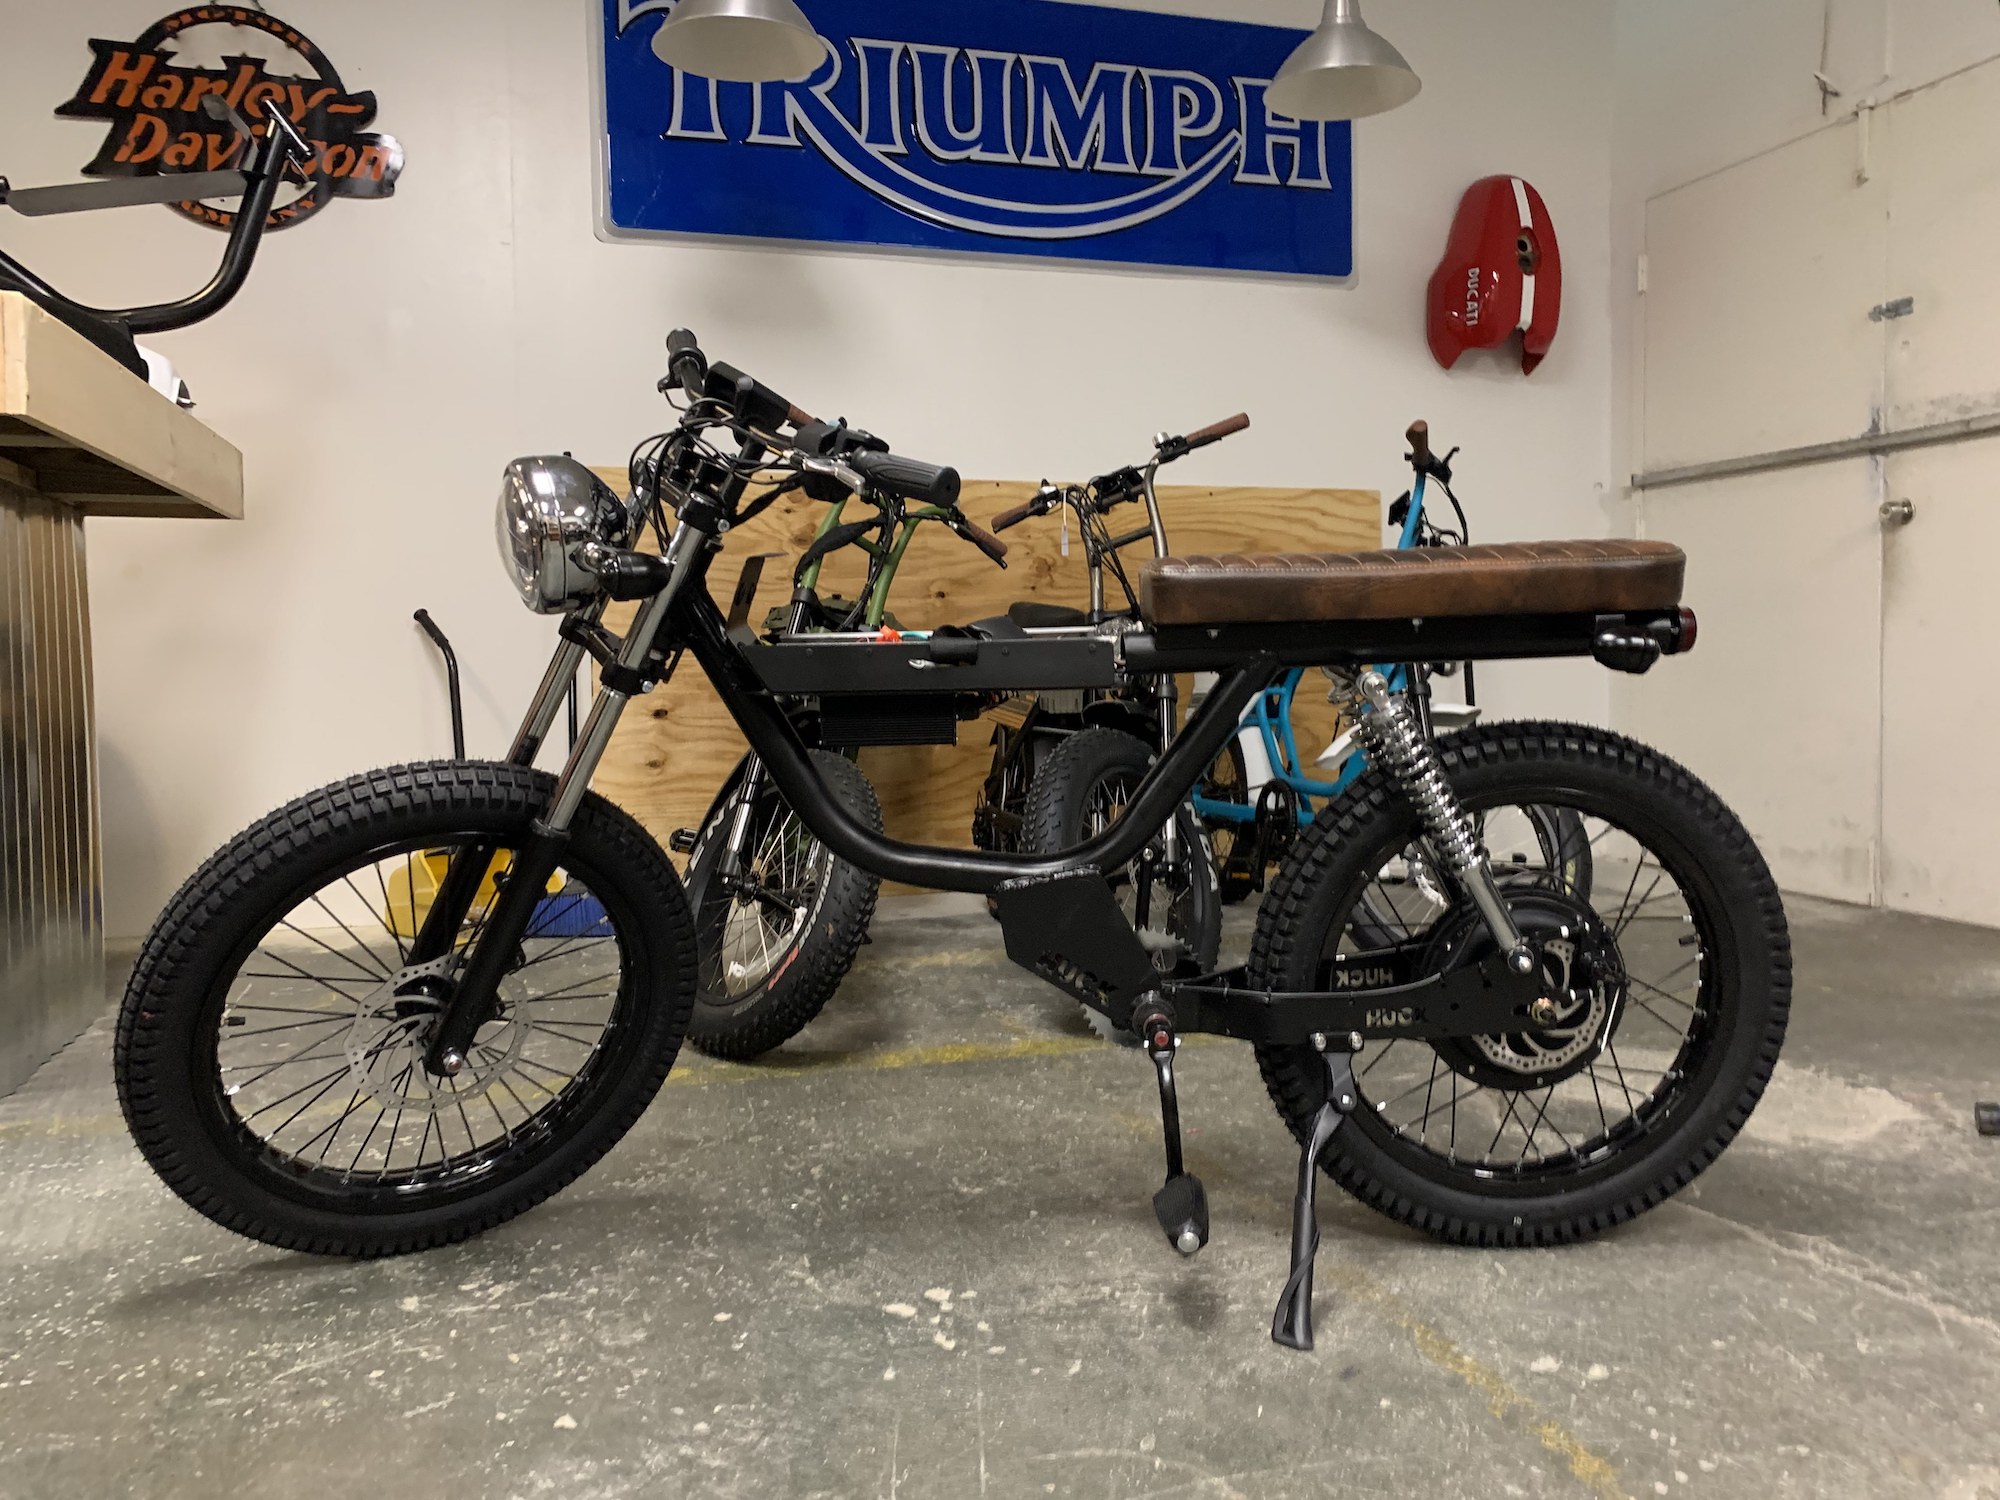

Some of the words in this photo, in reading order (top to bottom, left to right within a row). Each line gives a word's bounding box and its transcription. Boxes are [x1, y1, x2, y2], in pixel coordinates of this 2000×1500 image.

[113, 113, 391, 180] Davson
[1465, 267, 1480, 327] DUCATI
[1365, 1007, 1427, 1028] HUCK
